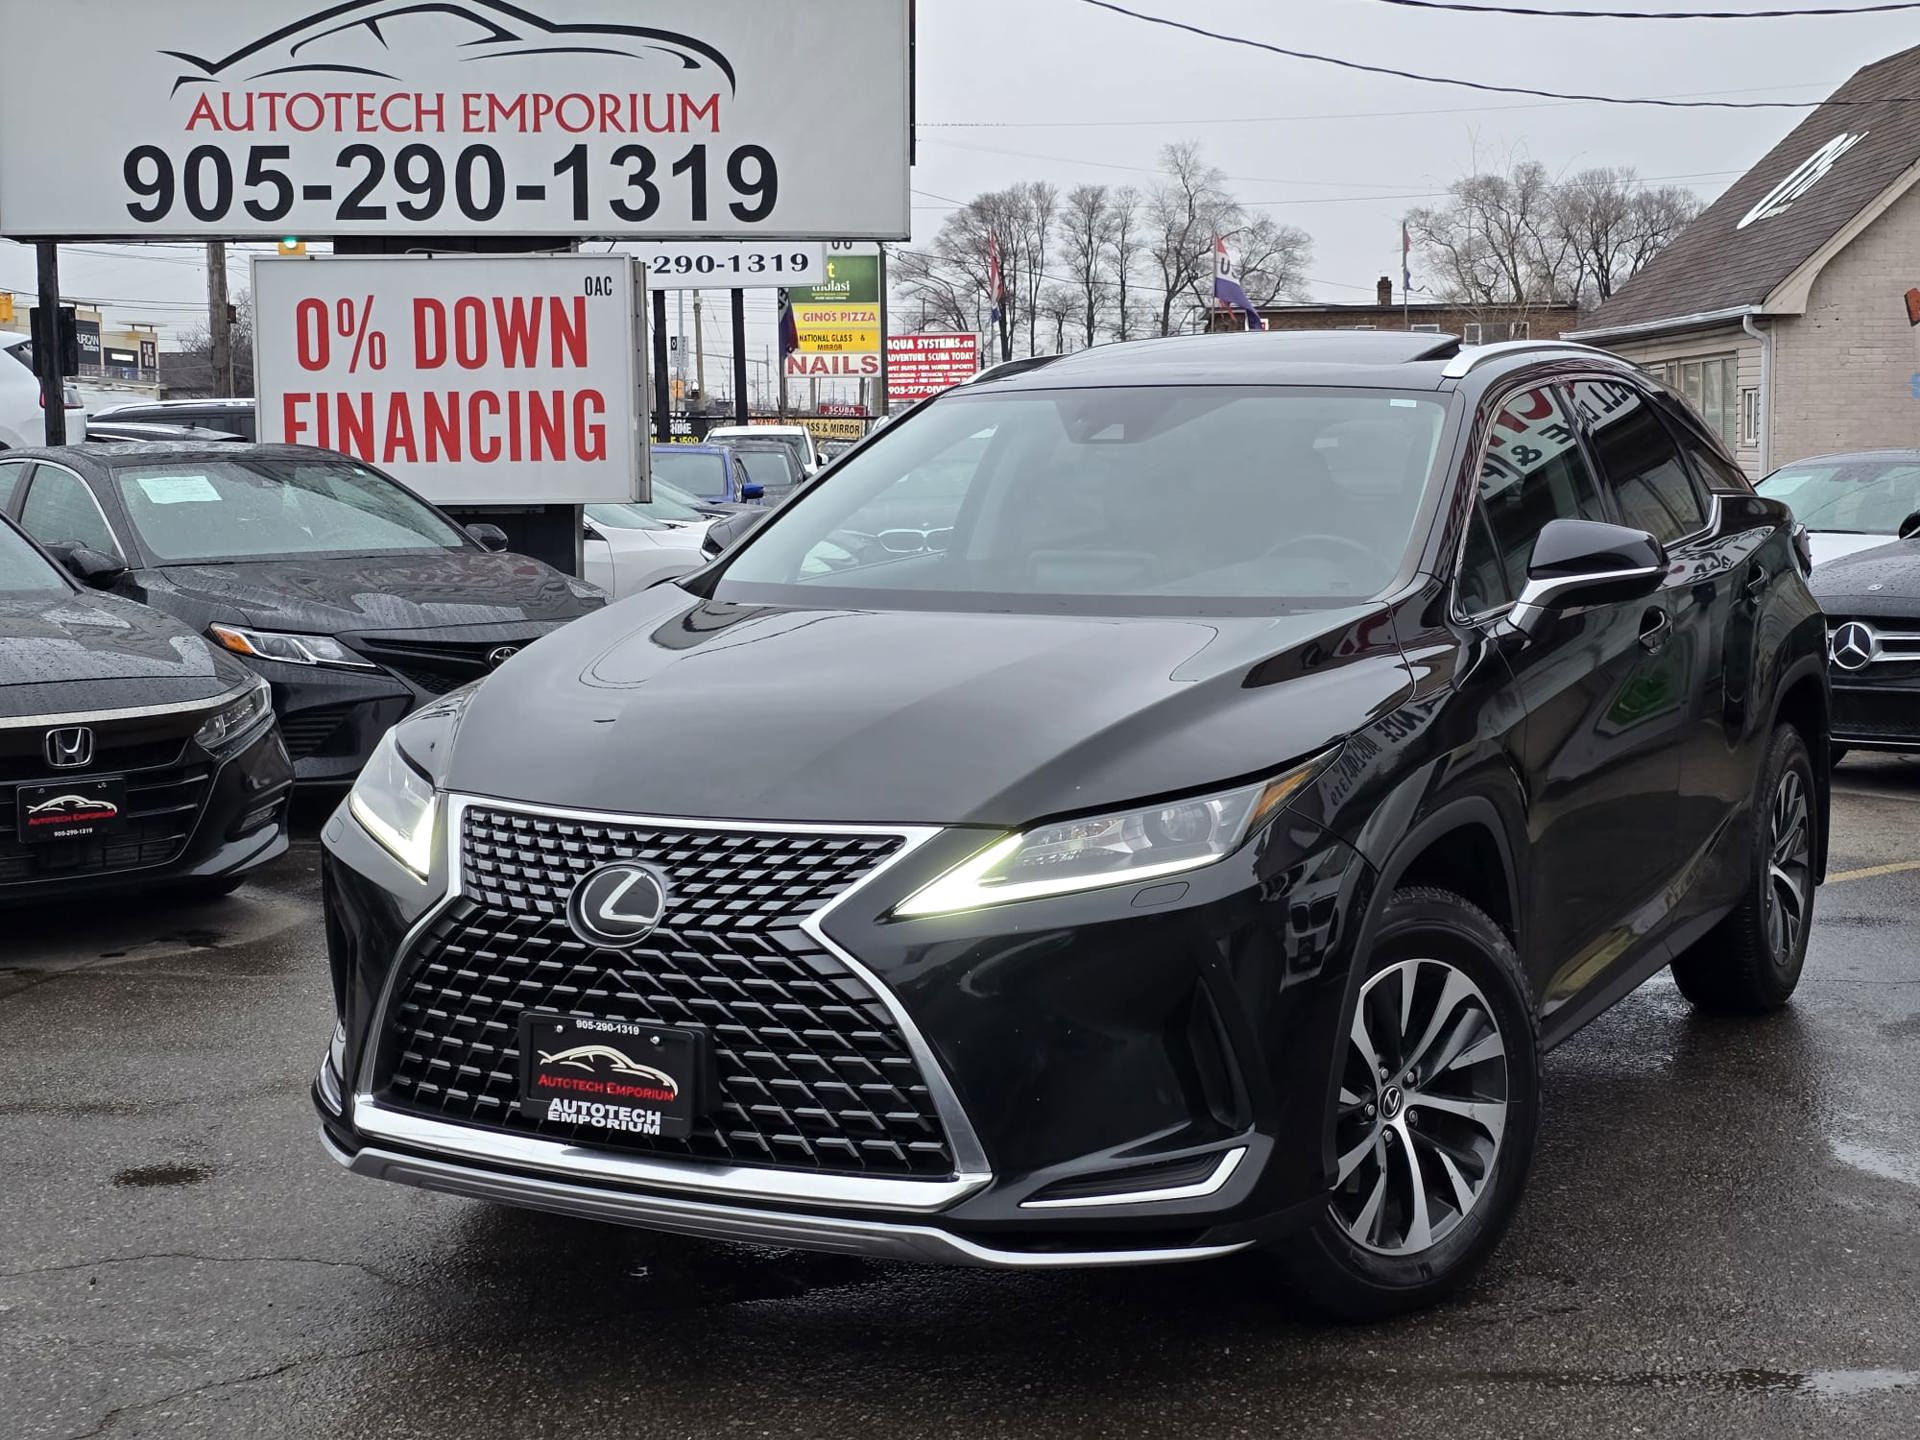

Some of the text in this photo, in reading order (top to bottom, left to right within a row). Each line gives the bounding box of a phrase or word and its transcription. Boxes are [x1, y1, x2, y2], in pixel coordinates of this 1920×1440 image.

[185, 92, 721, 133] AUTOTECH EMPORIUM
[123, 143, 778, 223] 905-290-1319
[631, 253, 809, 274] -290-1319
[584, 276, 613, 296] OAC
[803, 311, 876, 322] GINO'S PIZZA
[296, 295, 588, 374] 0% DOWN
[799, 334, 829, 342] NATIONAL
[831, 334, 853, 342] GLASS
[887, 338, 974, 350] AQUA SYSTEMS.ca
[787, 356, 879, 374] NAILS
[928, 352, 949, 361] SCUBA
[951, 352, 974, 360] TODAY
[283, 389, 607, 464] FINANCING
[830, 423, 860, 434] MIRROR
[576, 1020, 640, 1035] 905-290-1319
[538, 1074, 675, 1102] AUTOTECH EMPORIUM
[549, 1098, 661, 1125] AUTOTECH
[547, 1110, 661, 1135] EMPORIUM
